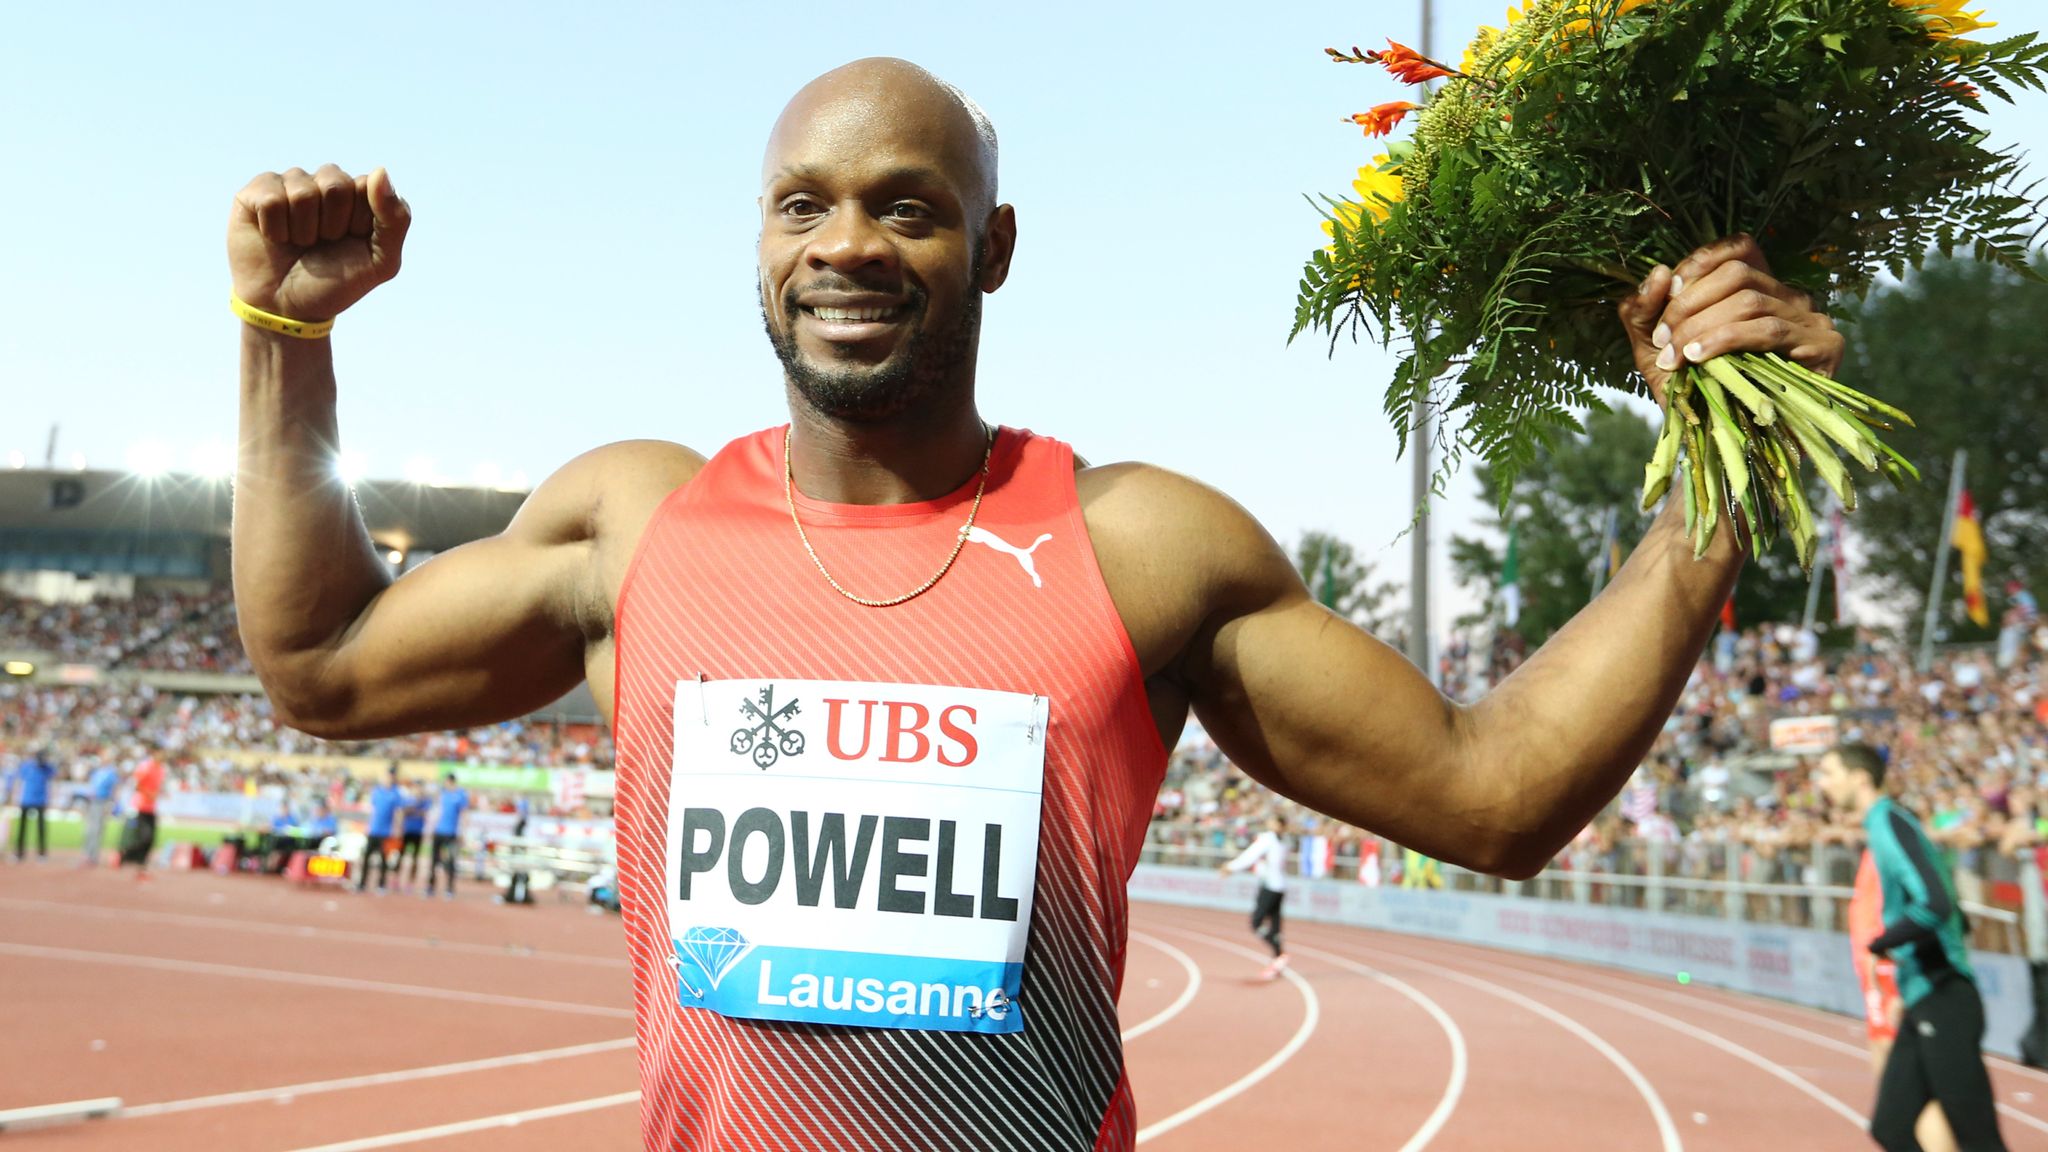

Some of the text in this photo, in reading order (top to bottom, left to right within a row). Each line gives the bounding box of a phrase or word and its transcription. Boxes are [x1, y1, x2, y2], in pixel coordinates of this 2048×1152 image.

[823, 698, 978, 767] UBS
[679, 807, 1018, 921] POWELL
[757, 959, 1009, 1020] Lausanne
